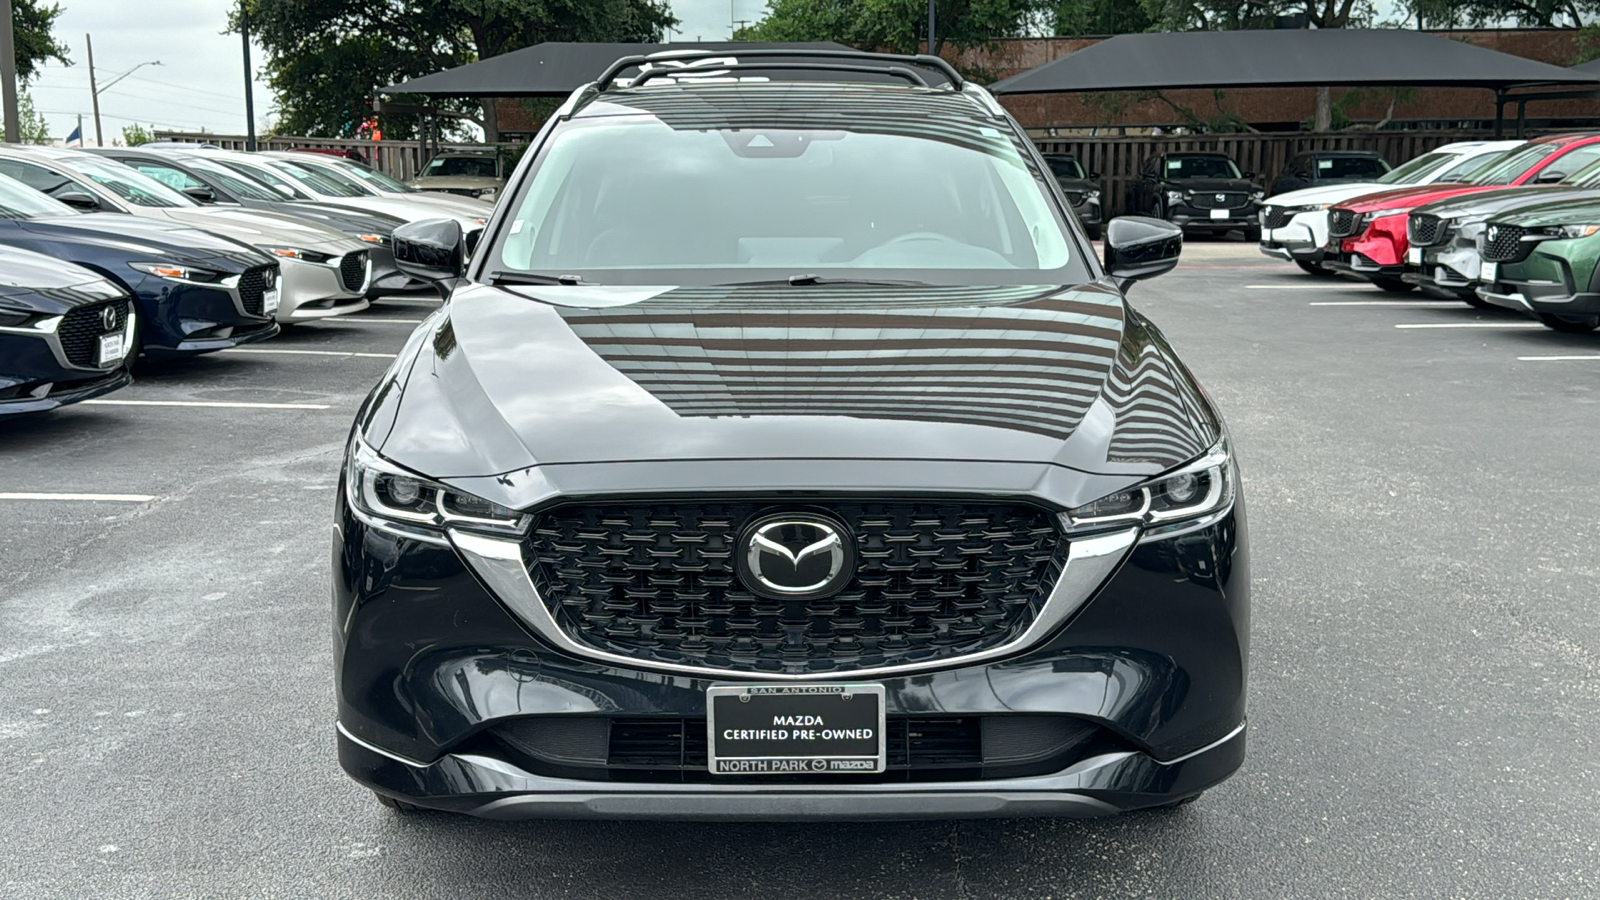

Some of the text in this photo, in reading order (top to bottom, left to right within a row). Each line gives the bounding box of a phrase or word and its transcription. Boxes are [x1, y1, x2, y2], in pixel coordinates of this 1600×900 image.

[773, 715, 824, 726] MAZDA
[723, 729, 873, 740] CERTIFIED PRE-OWNED
[719, 760, 874, 772] NORTH PARK mazda
